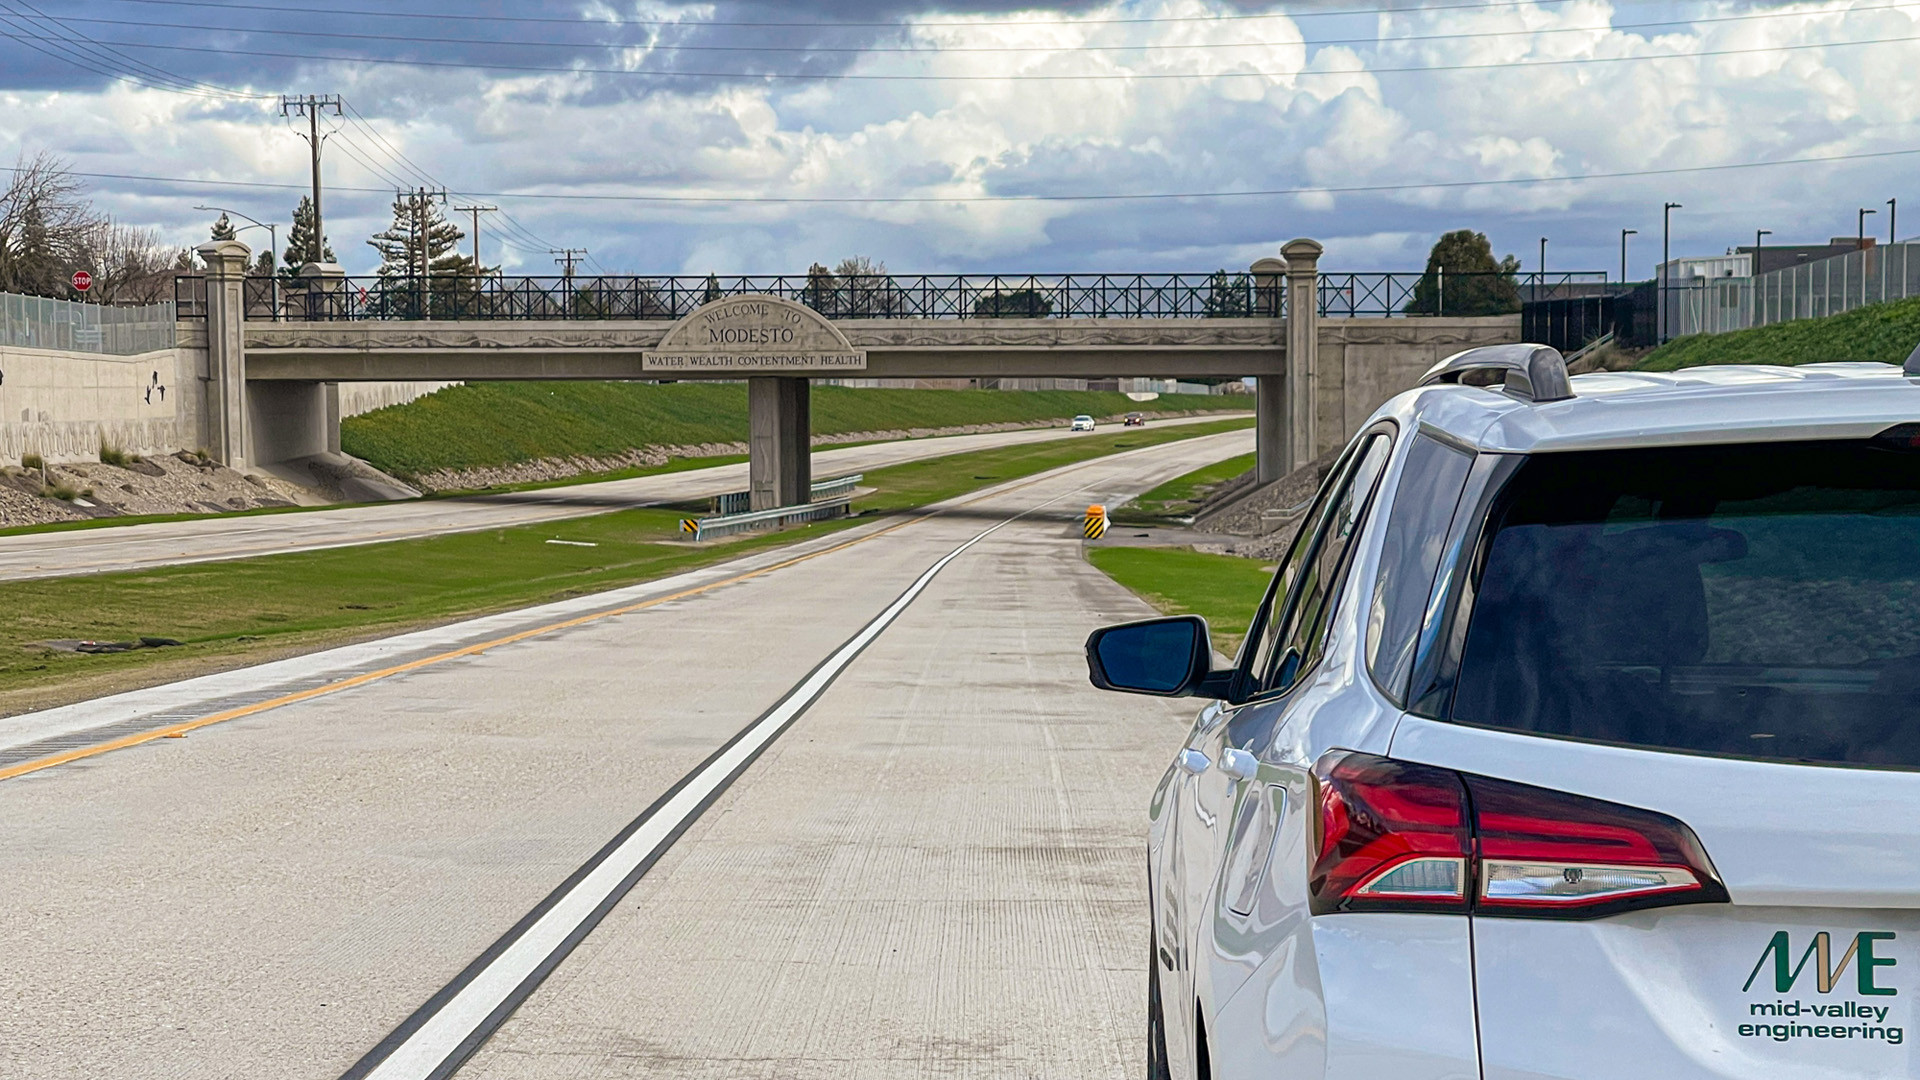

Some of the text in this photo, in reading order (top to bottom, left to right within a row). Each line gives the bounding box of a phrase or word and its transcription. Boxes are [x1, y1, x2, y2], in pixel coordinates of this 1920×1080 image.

[74, 277, 90, 285] STOP
[704, 304, 801, 324] WELCOME TO
[709, 328, 794, 343] MODESTO
[649, 356, 861, 366] WATER WEALTH CONTENTMENT HEALTH
[1750, 1000, 1889, 1023] mid-valley
[1738, 1021, 1903, 1044] engineering
